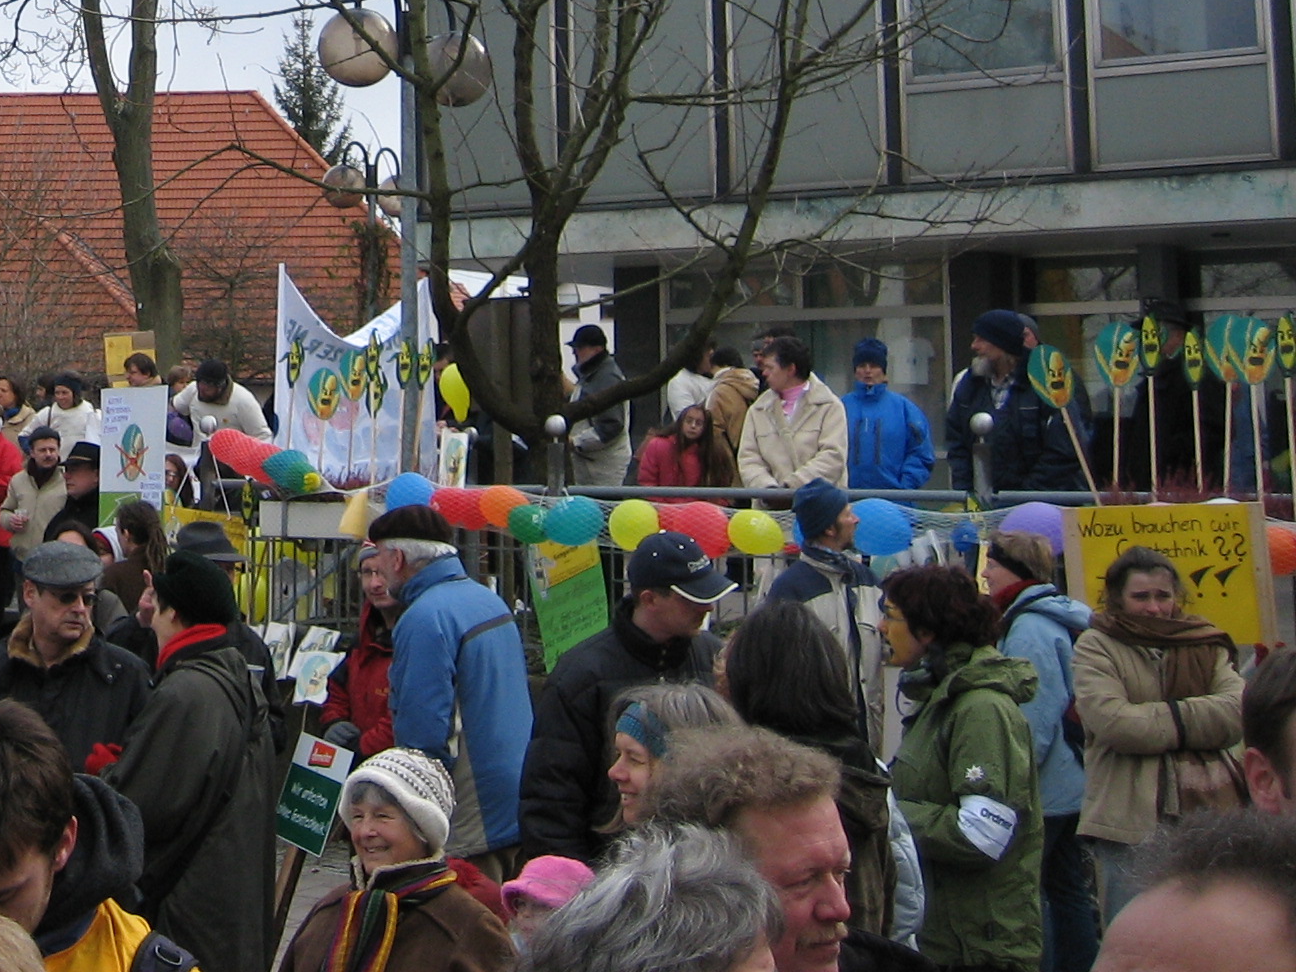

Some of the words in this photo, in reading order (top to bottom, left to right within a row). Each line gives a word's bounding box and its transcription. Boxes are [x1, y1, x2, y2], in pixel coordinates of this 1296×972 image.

[1077, 511, 1124, 538] Wozu
[1131, 512, 1203, 534] brauchen
[1211, 513, 1240, 533] wir
